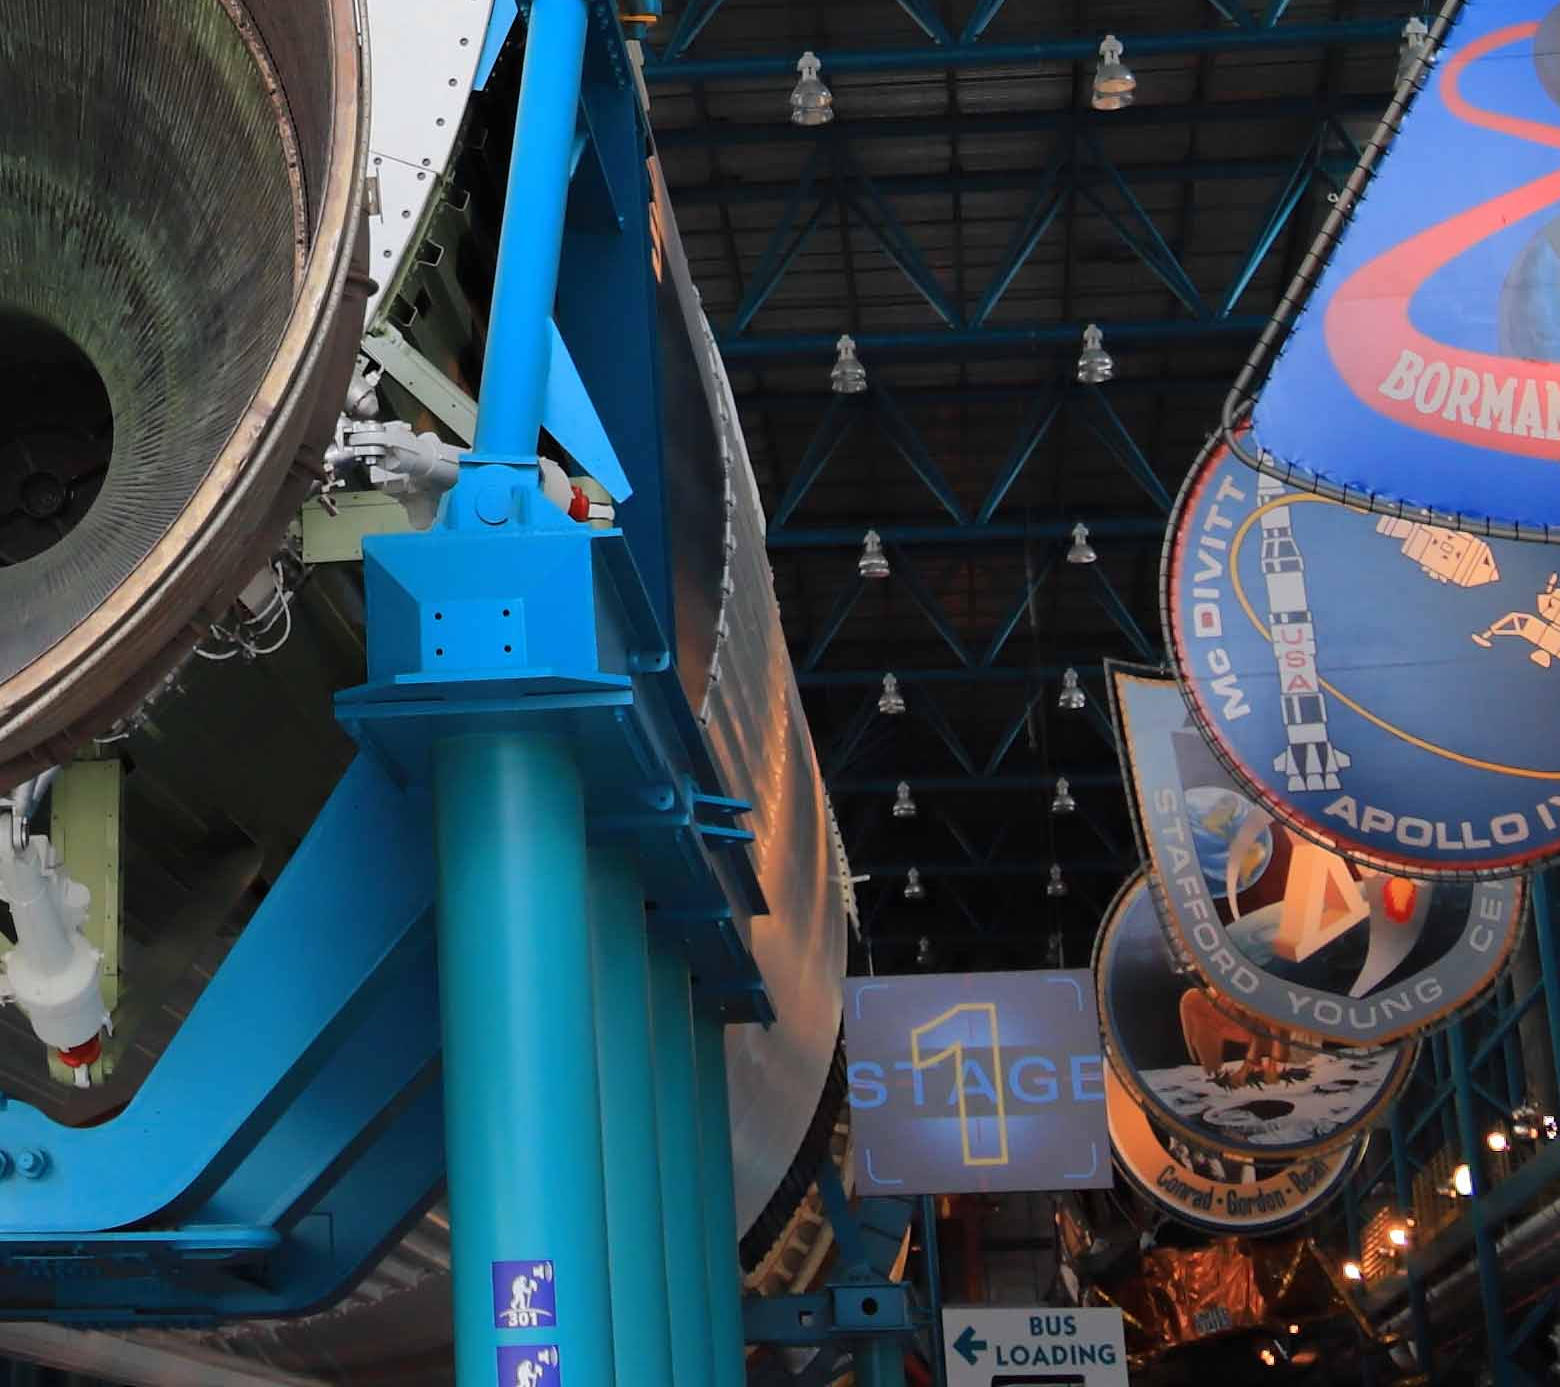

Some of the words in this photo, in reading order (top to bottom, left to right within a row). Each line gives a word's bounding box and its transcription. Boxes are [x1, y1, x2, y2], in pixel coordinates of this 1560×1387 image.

[1281, 629, 1313, 691] USA
[1323, 796, 1530, 850] APOLLO
[1154, 789, 1261, 995] STAFFORD
[1288, 978, 1443, 1026] YOUNG
[847, 1055, 1105, 1109] STAGE
[912, 1004, 1008, 1165] 1
[1157, 1165, 1214, 1211] Conrad
[1227, 1188, 1286, 1216] Gordon
[507, 1312, 538, 1327] 301
[1030, 1316, 1077, 1336] BUS
[996, 1344, 1116, 1366] LOADING
